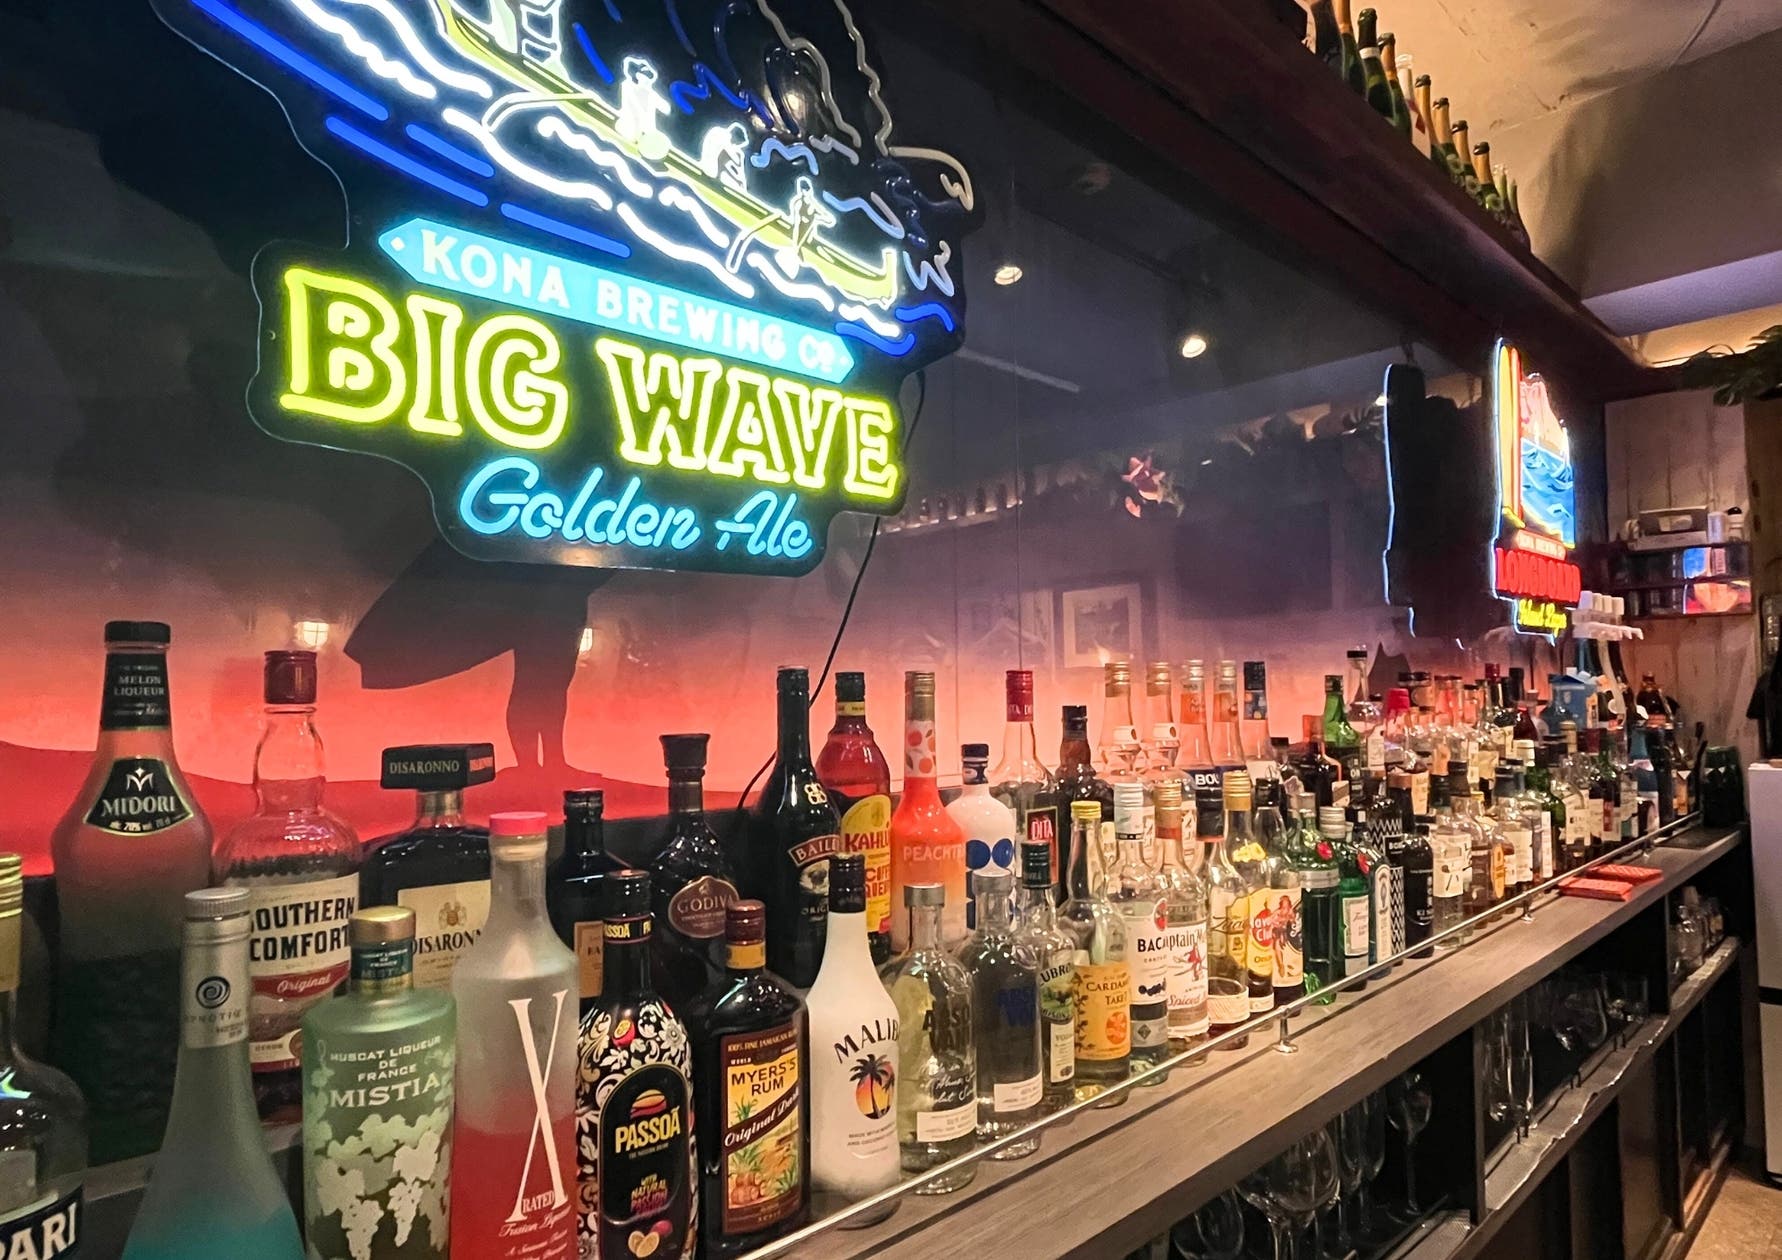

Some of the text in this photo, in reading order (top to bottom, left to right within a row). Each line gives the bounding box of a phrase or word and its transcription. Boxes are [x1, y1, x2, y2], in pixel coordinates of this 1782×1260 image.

[420, 228, 571, 310] KONA
[595, 278, 788, 362] BREWING
[280, 267, 900, 500] BIG WAVE
[460, 455, 814, 559] Golden Ale
[114, 687, 165, 697] LIQUEUR
[118, 675, 161, 685] MELON
[389, 760, 460, 775] DISARONNO
[102, 795, 175, 817] MIDORI
[251, 897, 355, 932] OUTHERN
[677, 894, 734, 914] GODIVA
[249, 925, 349, 962] COMFORT
[277, 973, 331, 994] Original
[330, 1035, 441, 1062] MUSCAT LIQUEUR
[358, 1063, 417, 1082] FRANCE
[379, 1058, 397, 1070] DE
[330, 1071, 441, 1108] MISTIA
[752, 1076, 784, 1097] RUM
[724, 1108, 777, 1148] Original
[523, 1189, 556, 1213] RATED
[0, 1202, 77, 1260] ARI
